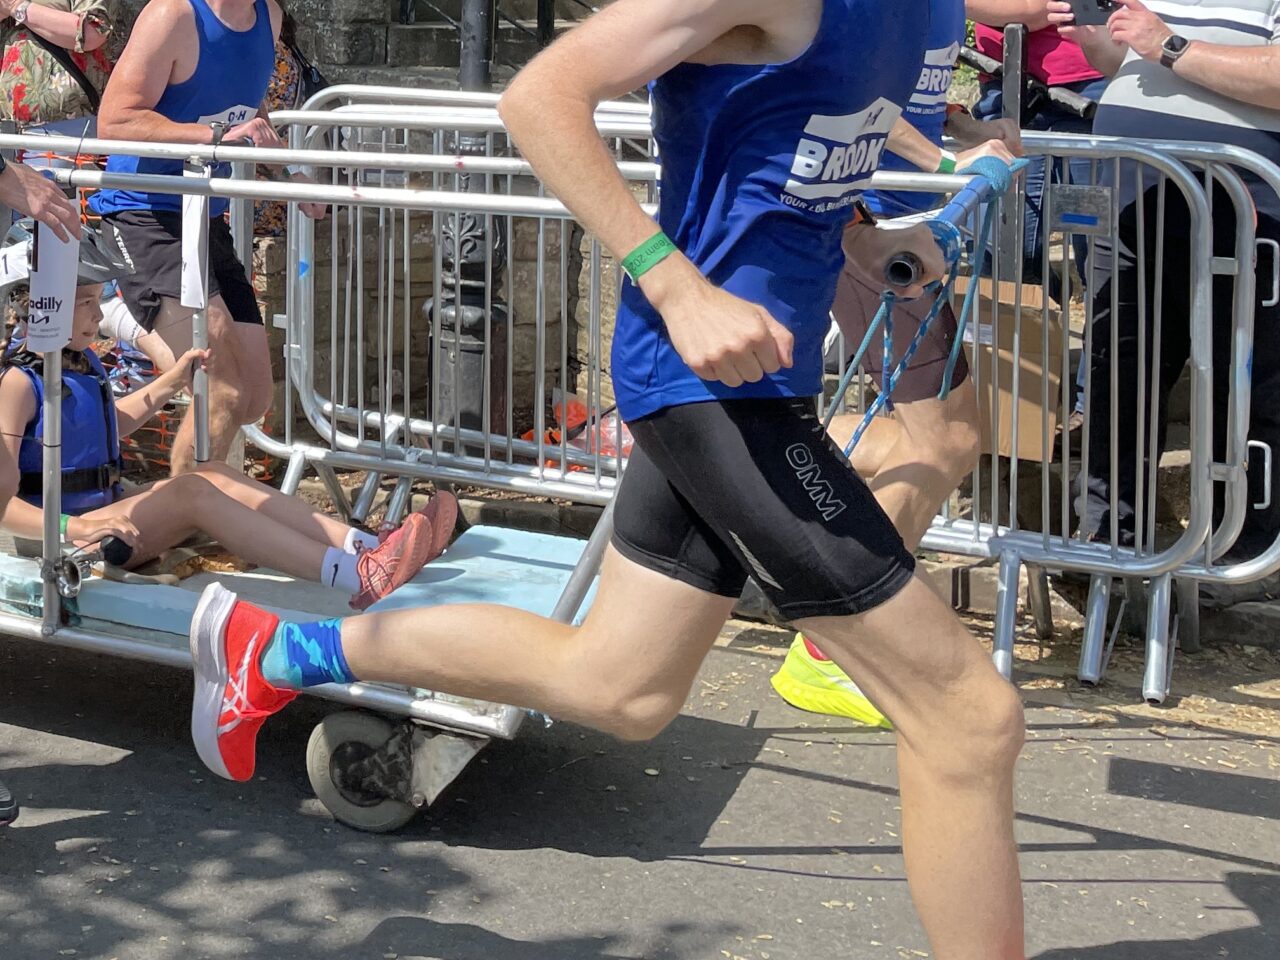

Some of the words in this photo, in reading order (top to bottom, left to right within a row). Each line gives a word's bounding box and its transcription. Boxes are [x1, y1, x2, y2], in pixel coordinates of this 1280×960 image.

[915, 67, 953, 92] BRO
[790, 137, 887, 181] BROOK
[780, 193, 808, 209] YOUR
[2, 253, 9, 275] 1
[785, 442, 848, 522] OMM
